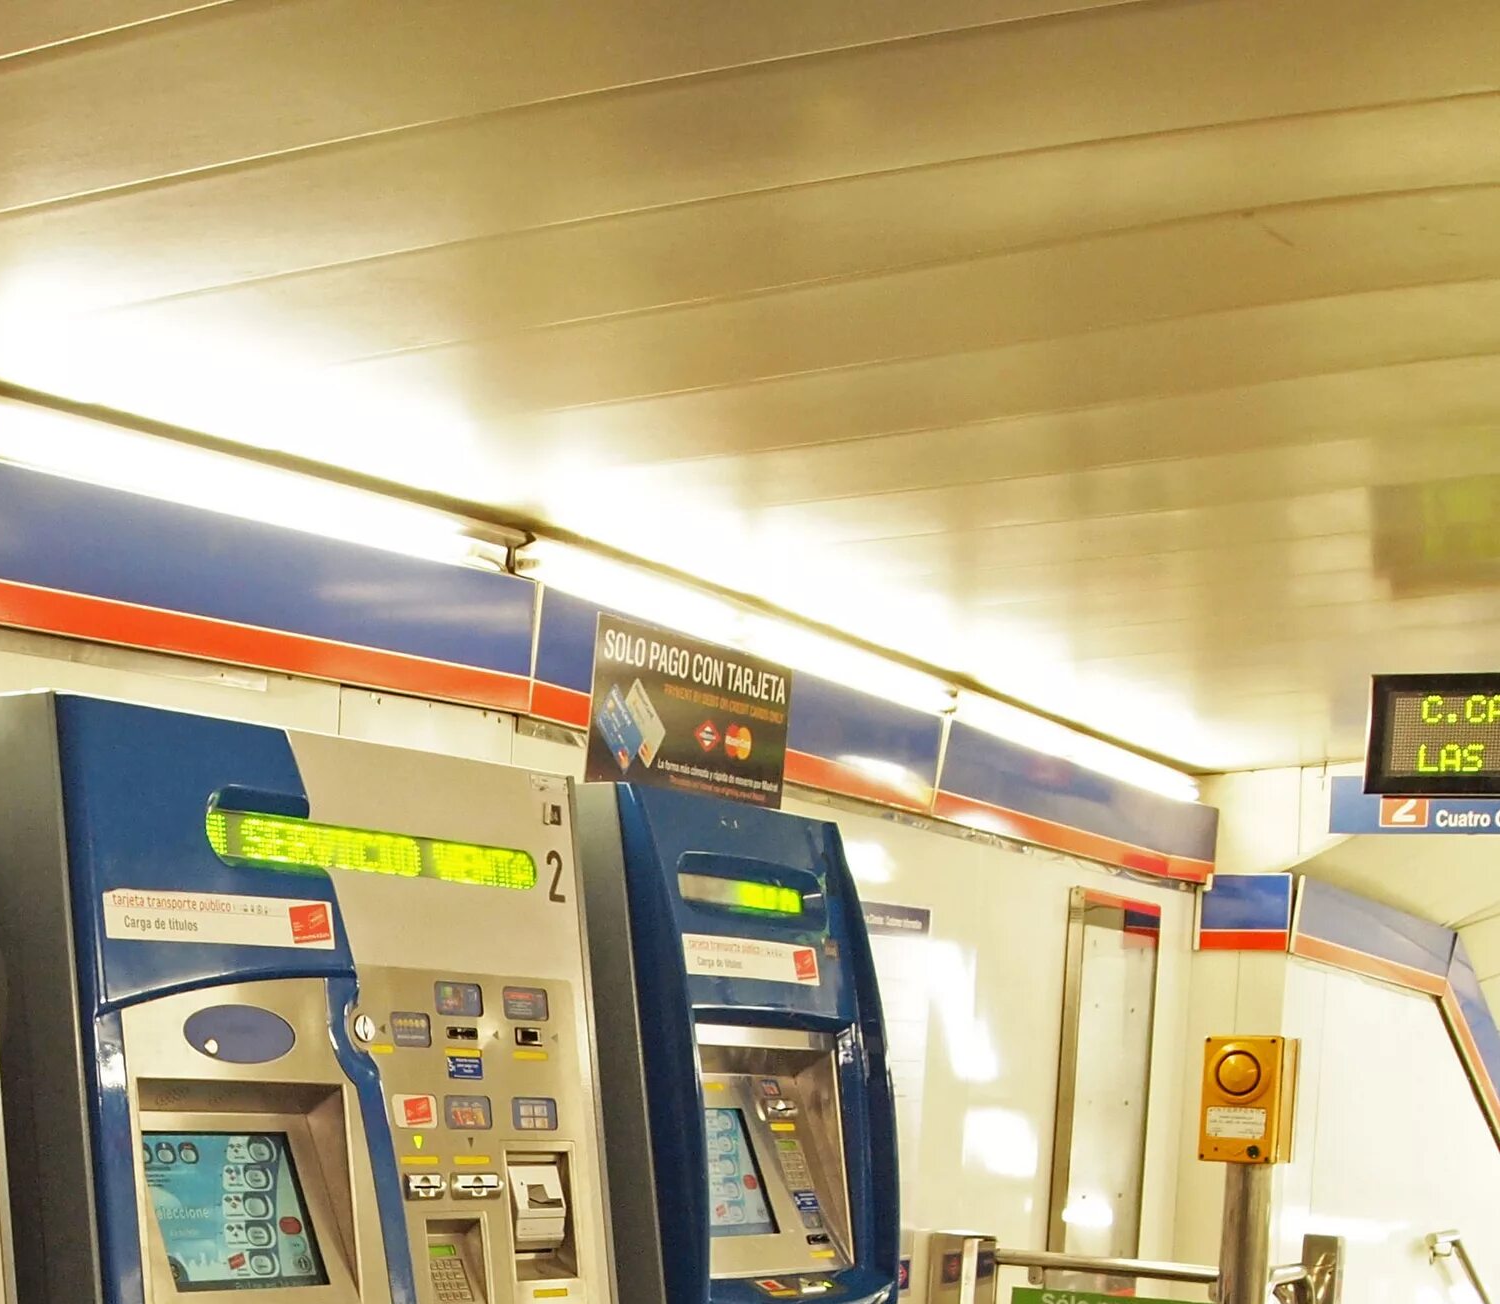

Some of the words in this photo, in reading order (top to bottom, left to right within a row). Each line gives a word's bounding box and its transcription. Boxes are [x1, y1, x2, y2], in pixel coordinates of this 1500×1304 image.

[604, 629, 646, 667] SOLO
[649, 642, 689, 678] PAGO
[692, 653, 723, 688] CON
[727, 663, 786, 705] TARJETA
[1417, 744, 1485, 772] LAS
[1392, 799, 1417, 823] 2
[1436, 809, 1491, 827] Cuatro
[546, 850, 566, 903] 2
[112, 893, 145, 907] tarjeta
[146, 895, 196, 911] transporte
[124, 915, 152, 931] Carga
[154, 916, 165, 930] de
